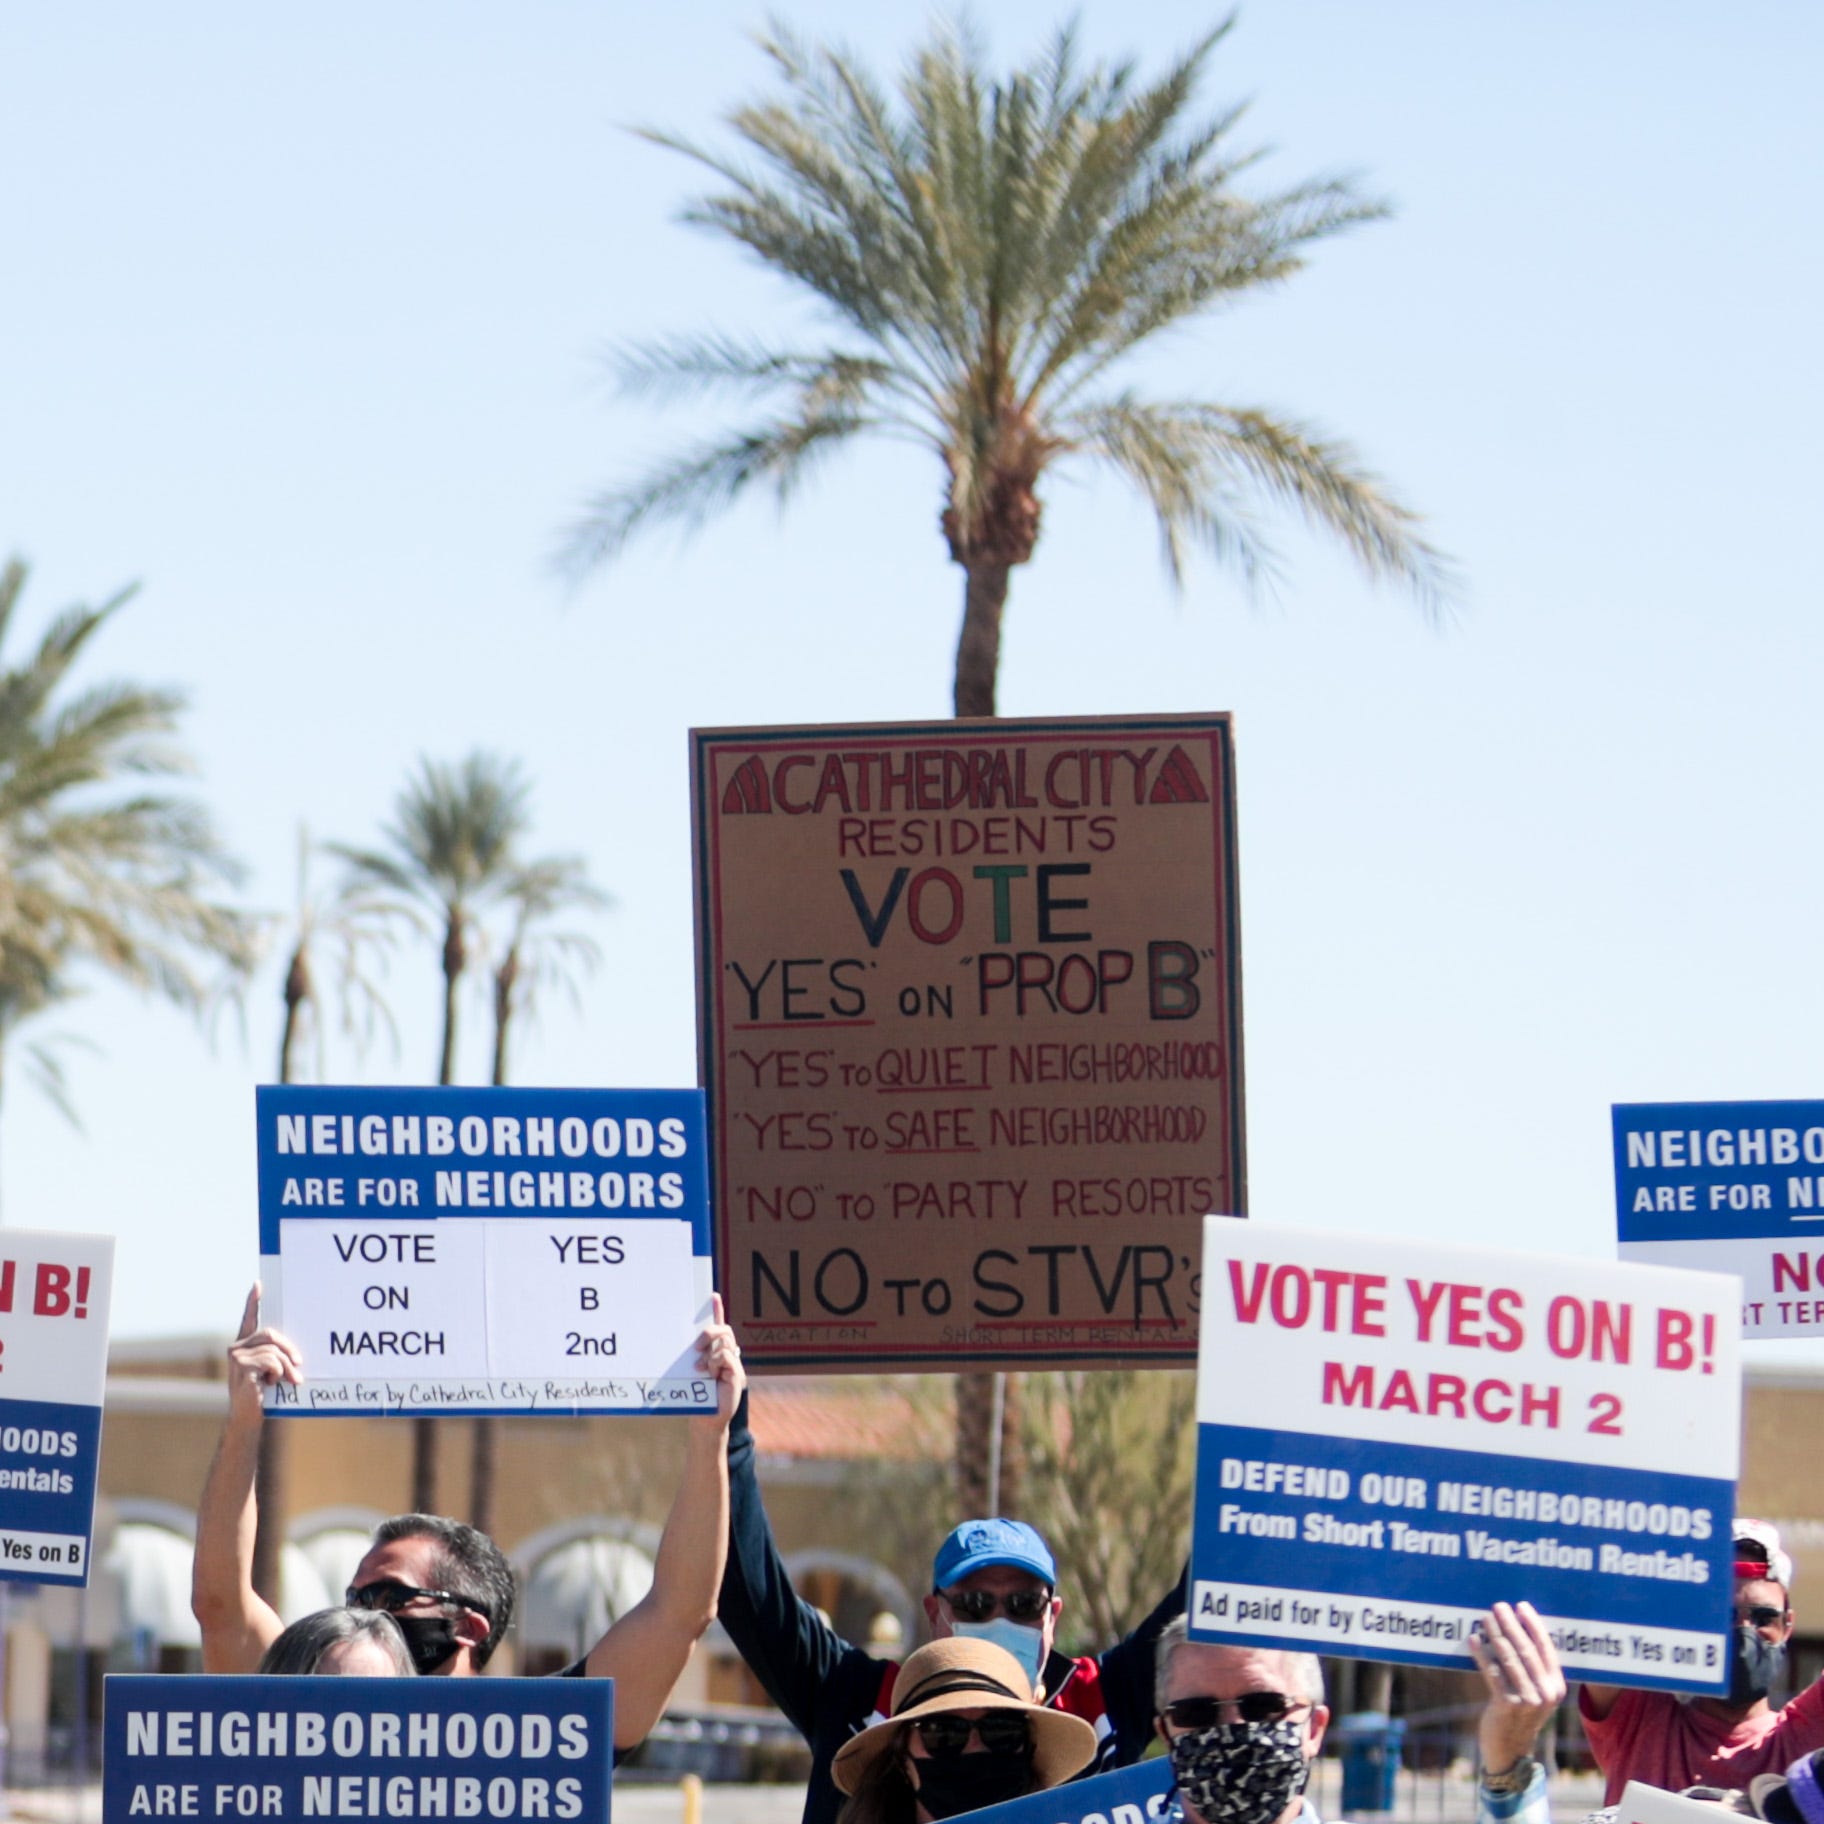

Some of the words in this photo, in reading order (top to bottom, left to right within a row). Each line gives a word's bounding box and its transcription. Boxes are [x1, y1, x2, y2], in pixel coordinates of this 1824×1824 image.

[772, 747, 1041, 813] CATHEDRAL
[1046, 746, 1156, 808] CITY
[840, 816, 1117, 856] RESIDENTS
[841, 863, 1092, 947] VOTE
[899, 984, 952, 1018] ON
[877, 1045, 998, 1086] QUIET
[277, 1115, 687, 1158] NEIGHBORHOODS
[885, 1108, 975, 1149] SAFE
[990, 1107, 1206, 1148] NEIGHBORHOOD
[282, 1179, 344, 1206] ARE
[358, 1179, 419, 1207] FOR
[436, 1171, 684, 1208] NEIGHBORS
[1633, 1186, 1696, 1212] ARE
[1710, 1184, 1771, 1210] FOR
[332, 1234, 436, 1263] VOTE
[551, 1236, 625, 1264] YES
[33, 1263, 91, 1320] B!
[363, 1286, 408, 1311] ON
[581, 1287, 600, 1311] B
[752, 1247, 869, 1317] NO
[884, 1279, 952, 1315] TO
[1228, 1259, 1387, 1338] VOTE
[1406, 1278, 1524, 1352] YES
[1547, 1295, 1632, 1365] ON
[1656, 1308, 1716, 1375] B!
[331, 1332, 444, 1355] MARCH
[565, 1332, 617, 1357] 2nd
[127, 1711, 589, 1760] NEIGHBORHOODS
[129, 1785, 199, 1816] ARE
[216, 1785, 283, 1816] FOR
[302, 1776, 583, 1819] NEIGHBORS
